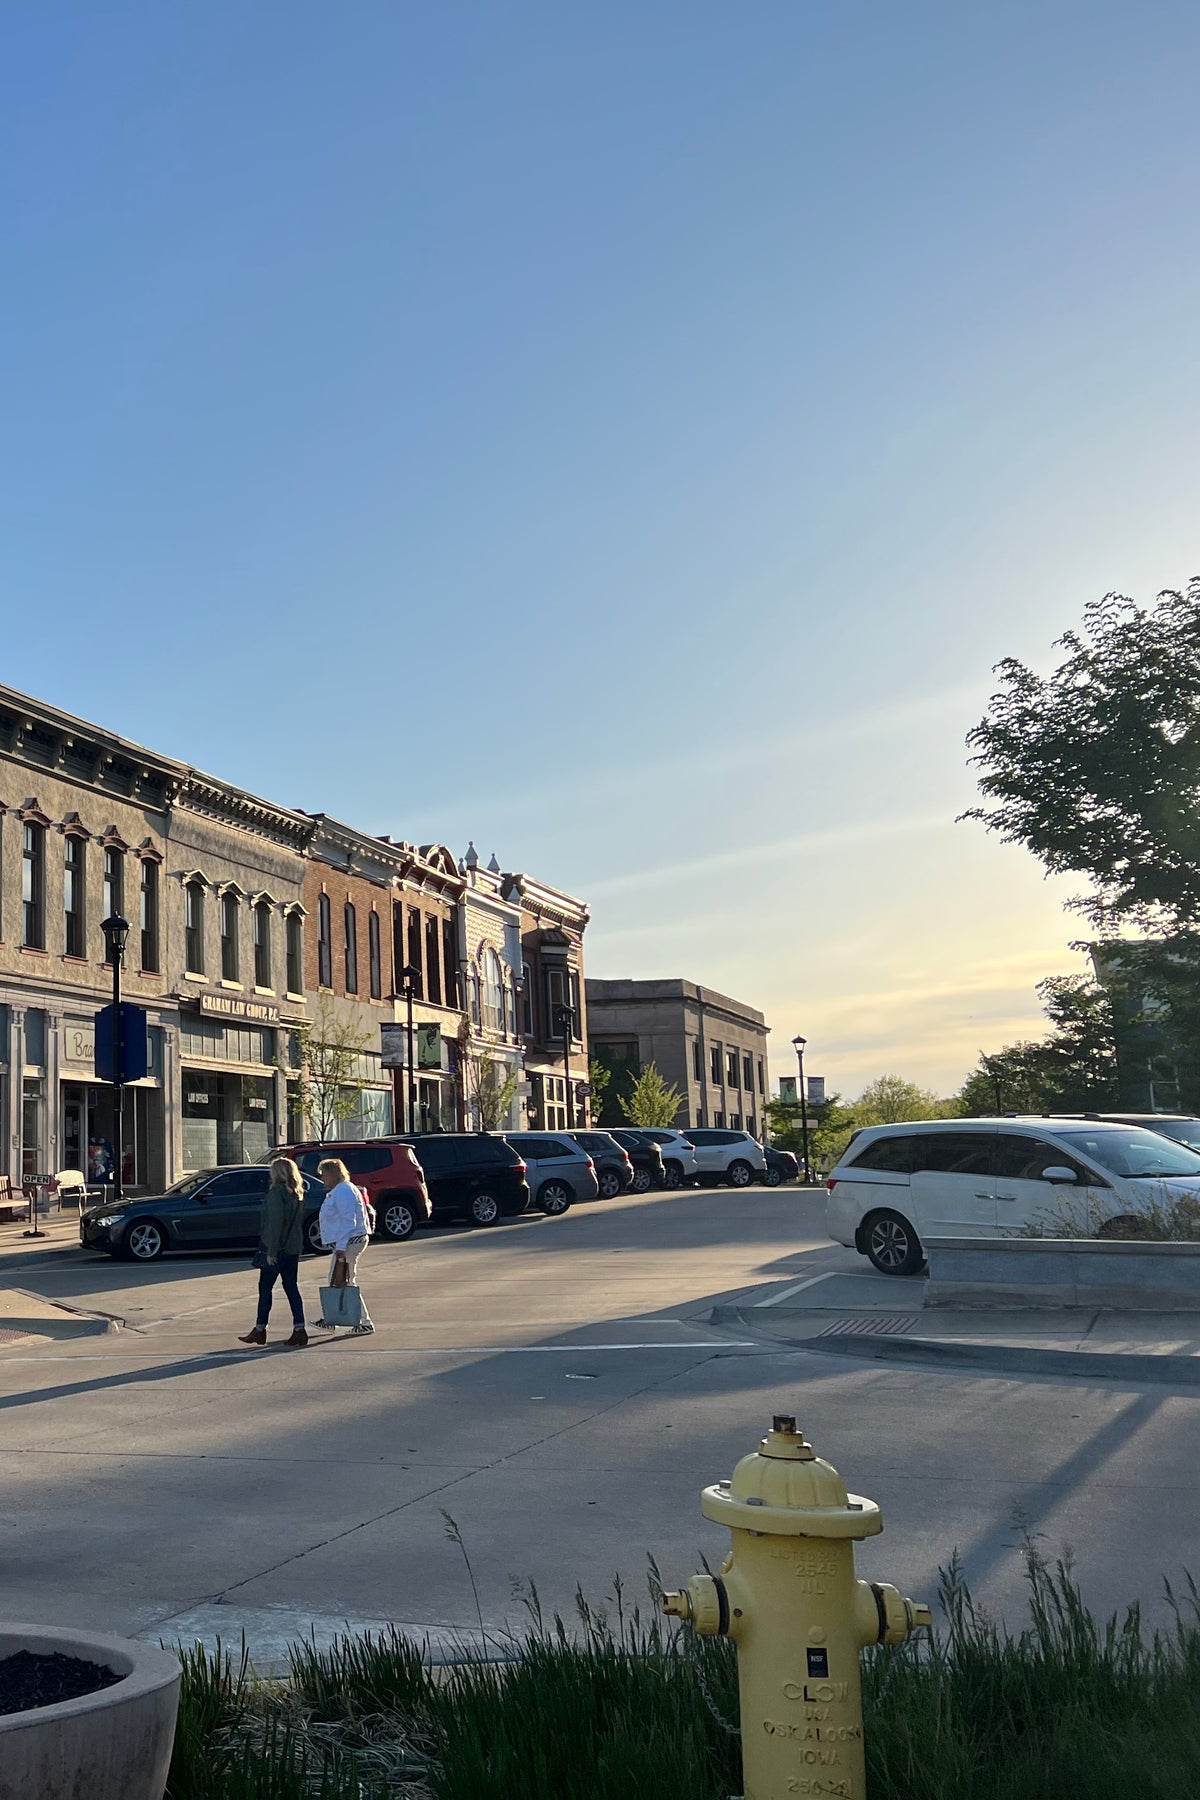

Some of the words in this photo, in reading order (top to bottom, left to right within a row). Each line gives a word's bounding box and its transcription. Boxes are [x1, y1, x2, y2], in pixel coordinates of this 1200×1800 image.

[202, 995, 231, 1013] GRAHAM
[231, 1000, 246, 1015] LAW
[24, 1175, 49, 1184] OPEN
[783, 1682, 849, 1702] CLOW
[803, 1706, 832, 1721] USA
[799, 1748, 841, 1766] IOWA
